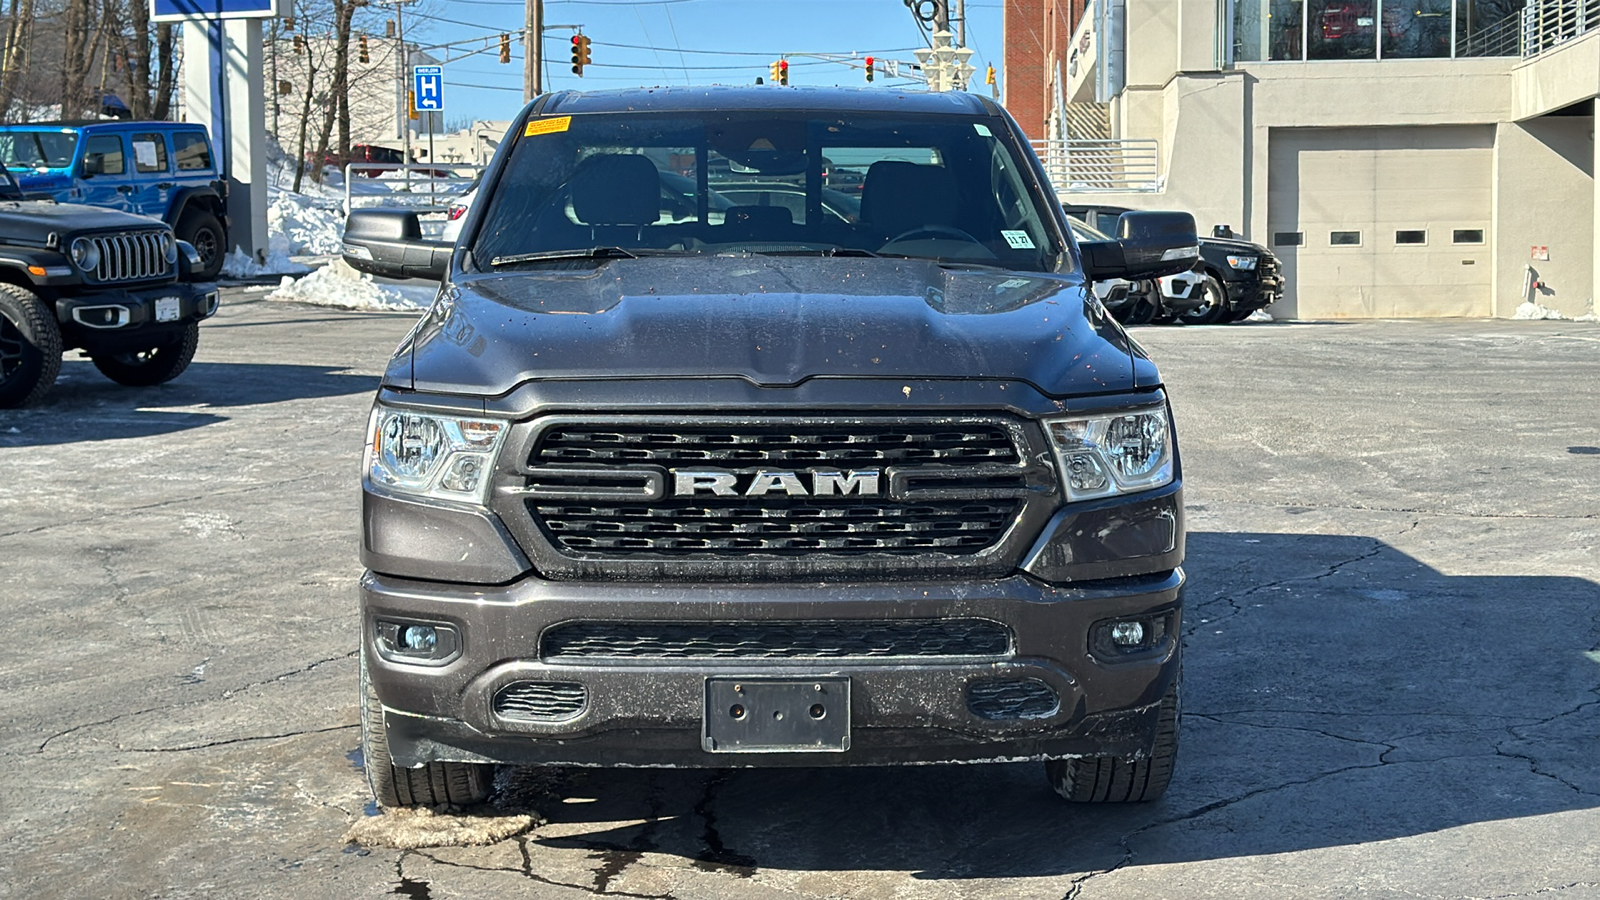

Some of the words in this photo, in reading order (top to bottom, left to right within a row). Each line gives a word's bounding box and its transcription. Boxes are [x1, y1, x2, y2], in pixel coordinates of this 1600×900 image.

[421, 76, 437, 97] H
[1007, 236, 1019, 244] 11
[674, 470, 880, 496] RAM
